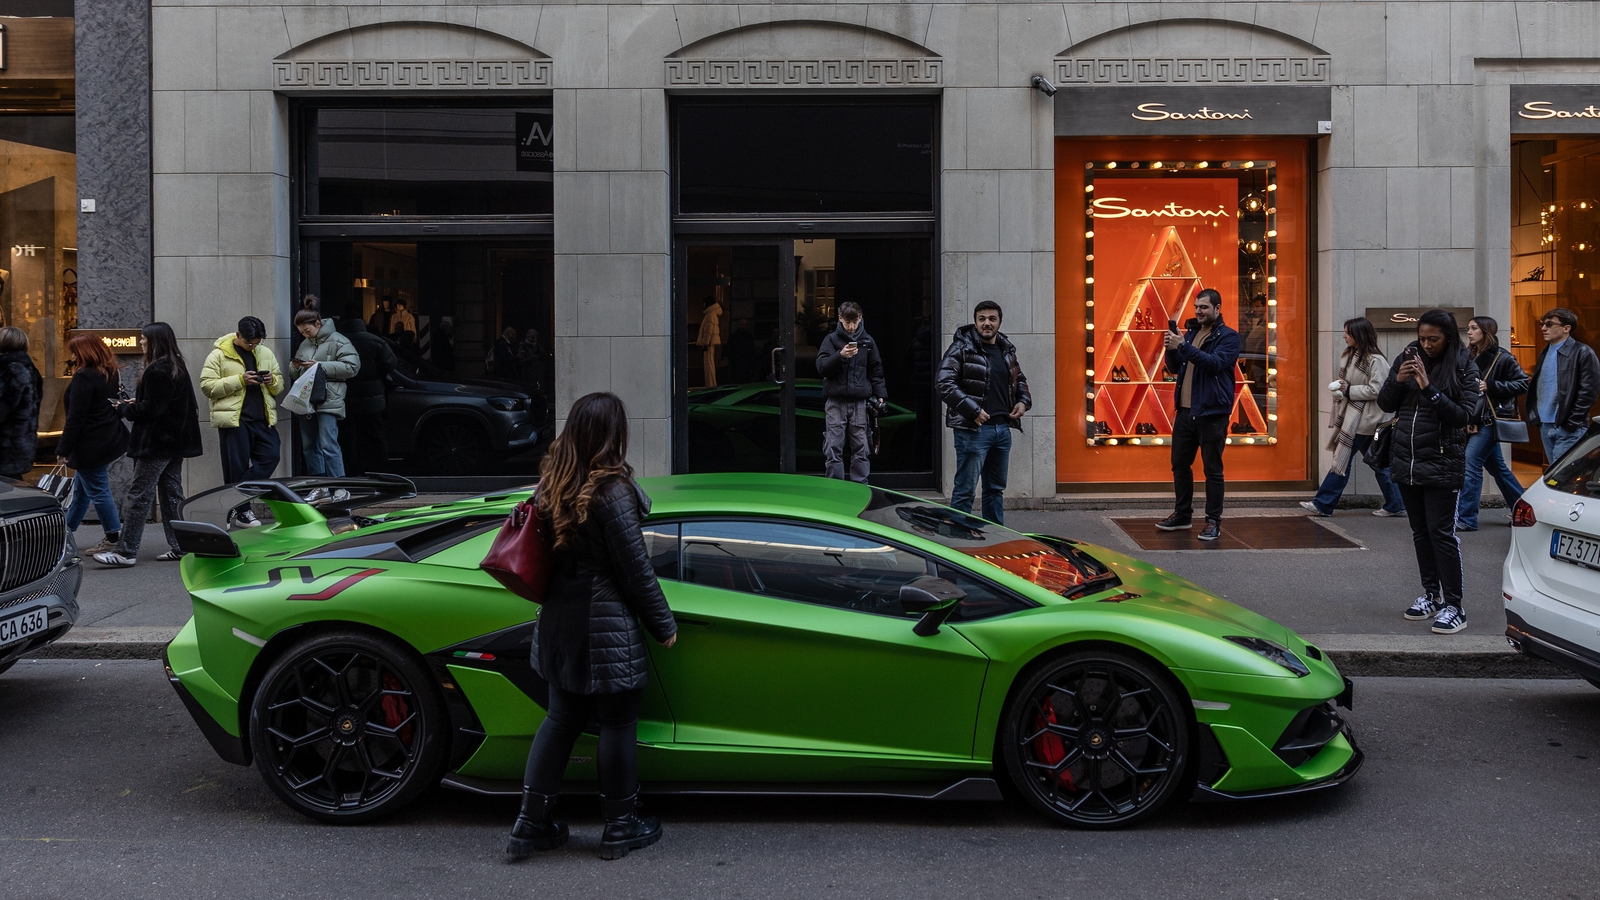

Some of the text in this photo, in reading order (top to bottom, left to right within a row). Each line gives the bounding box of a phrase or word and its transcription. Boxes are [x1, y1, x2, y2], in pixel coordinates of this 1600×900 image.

[1131, 102, 1253, 121] Santoni
[1092, 197, 1230, 219] Santoni
[1390, 313, 1420, 323] Sa
[112, 336, 137, 347] cavalli
[21, 611, 43, 635] 636
